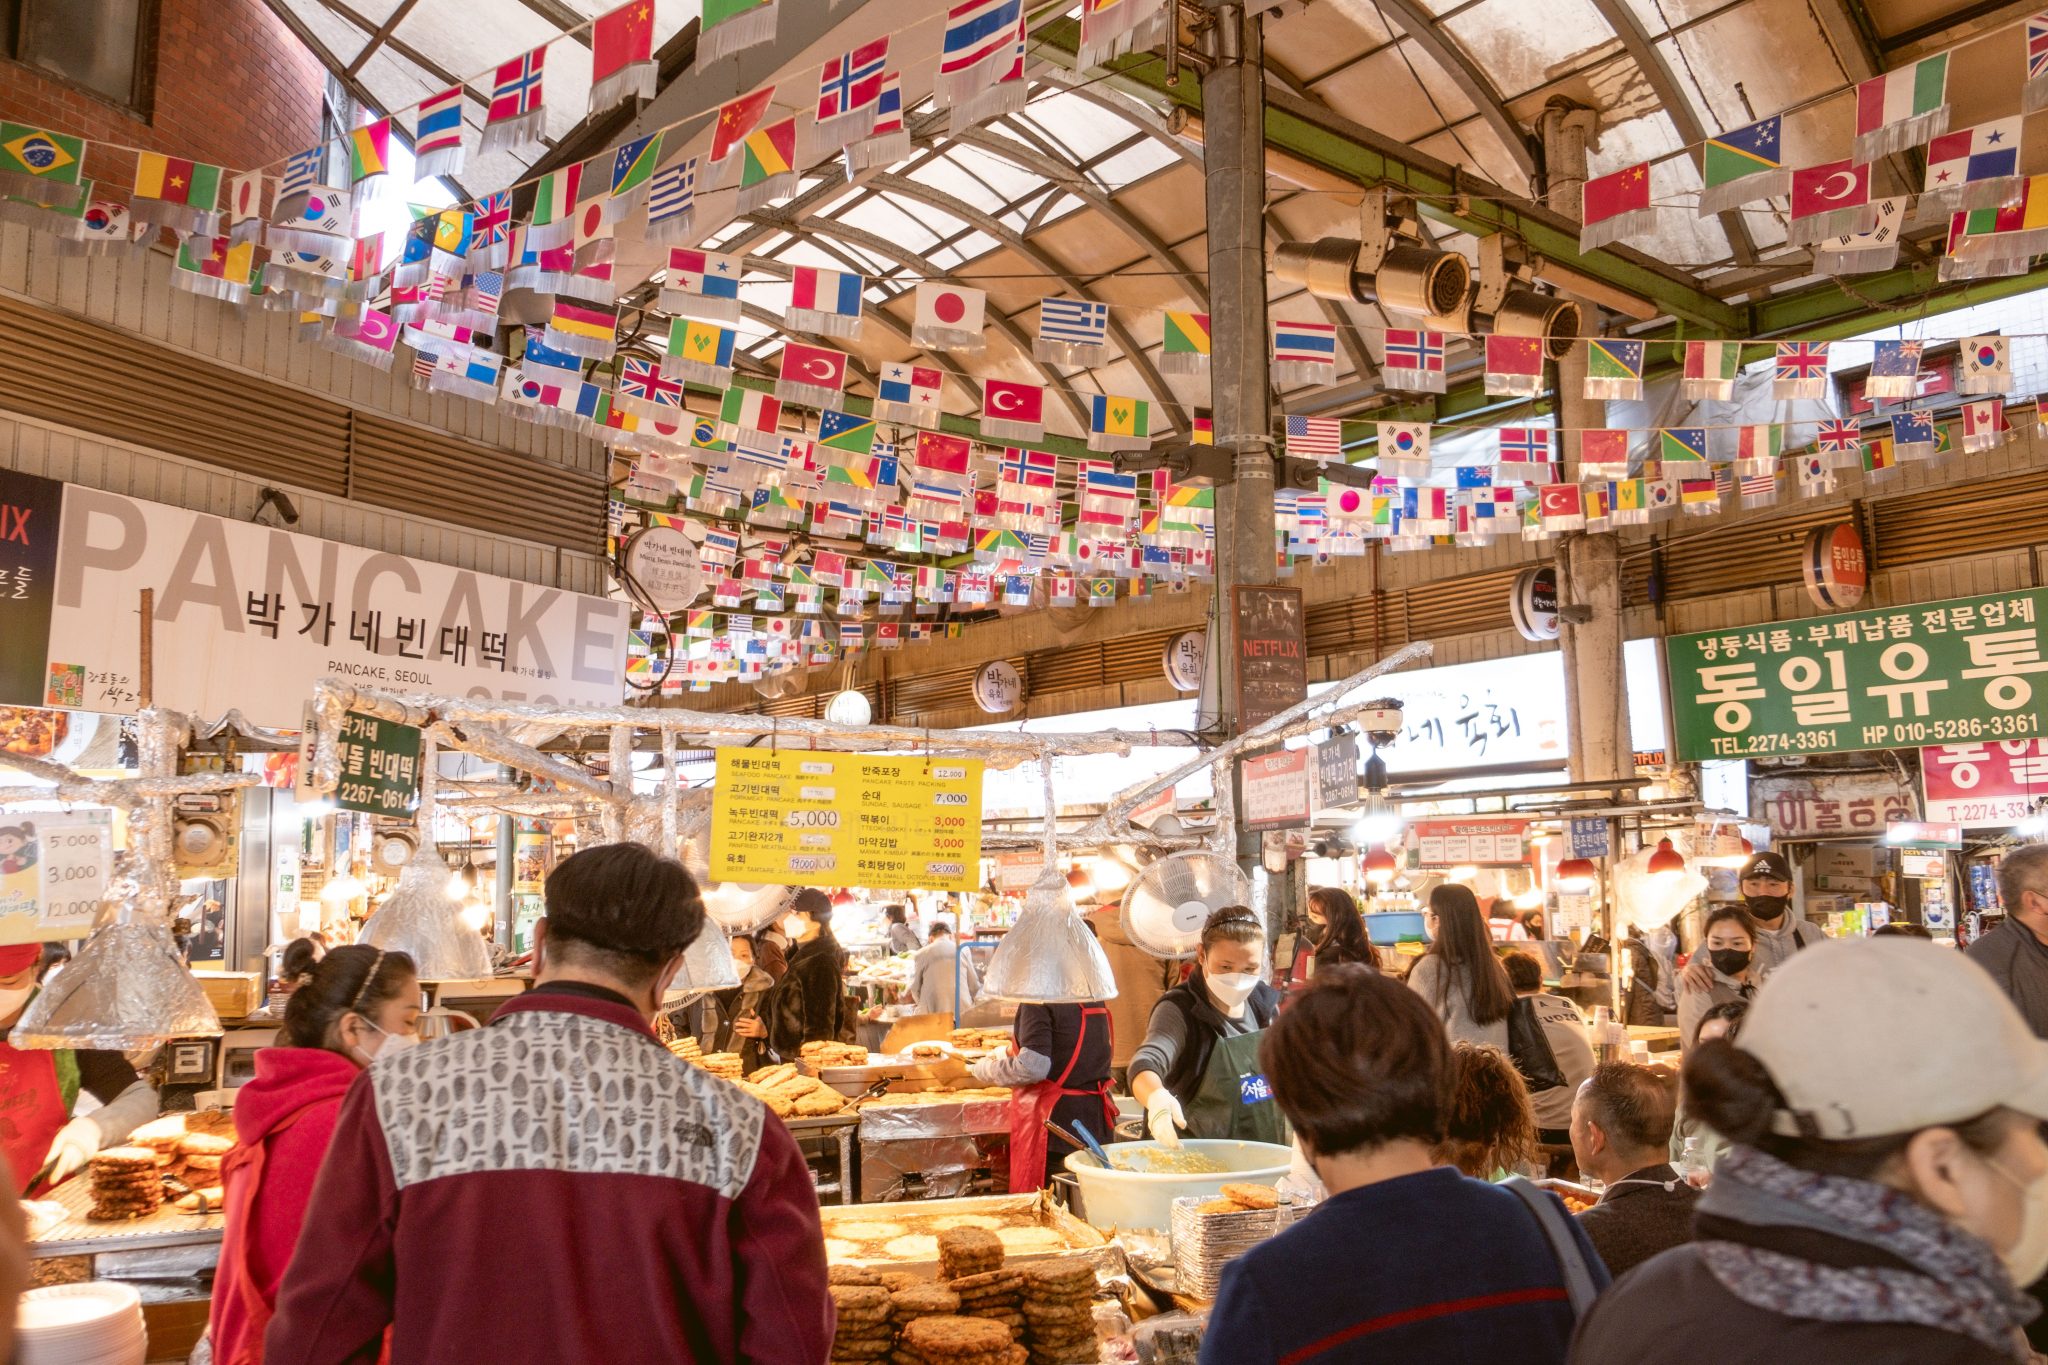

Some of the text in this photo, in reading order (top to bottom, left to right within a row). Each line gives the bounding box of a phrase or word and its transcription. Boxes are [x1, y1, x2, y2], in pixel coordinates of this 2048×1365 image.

[644, 541, 692, 557] 박가네 빈대떡
[1832, 546, 1865, 573] 동일유통
[56, 484, 617, 686] PANCAKE
[1921, 597, 2036, 637] 전문업체
[246, 590, 509, 672] 박가네빈대떡
[1242, 639, 1299, 657] NETFLIX
[328, 660, 433, 685] PANCAKE, SEOUL
[1181, 662, 1198, 675] 육회
[986, 668, 1017, 689] 박가네
[1695, 628, 2048, 733] 동일유통
[988, 688, 1004, 700] 육회
[1455, 688, 1521, 757] 육회
[1711, 713, 2039, 756] TEL.2274-3361 HP 010-5286-3361
[1321, 744, 1341, 762] 박가네
[1633, 753, 1665, 765] ETFLIX
[369, 748, 415, 786] 빈대떡
[730, 758, 781, 770] 해물빈대떡
[862, 765, 901, 777] 반죽포장
[340, 782, 411, 809] 2267-0614
[729, 784, 780, 795] 고기빈대떡
[861, 790, 881, 801] 순대
[935, 793, 968, 803] 7,000
[728, 807, 779, 820] 녹두빈대떡
[790, 811, 837, 828] 5,000
[860, 814, 890, 825] 떡볶이
[934, 817, 965, 828] 3,000
[728, 831, 784, 843] 고기완자2개
[858, 837, 898, 849] 마약김밥
[933, 838, 965, 849] 3,000
[726, 853, 746, 864] 육회
